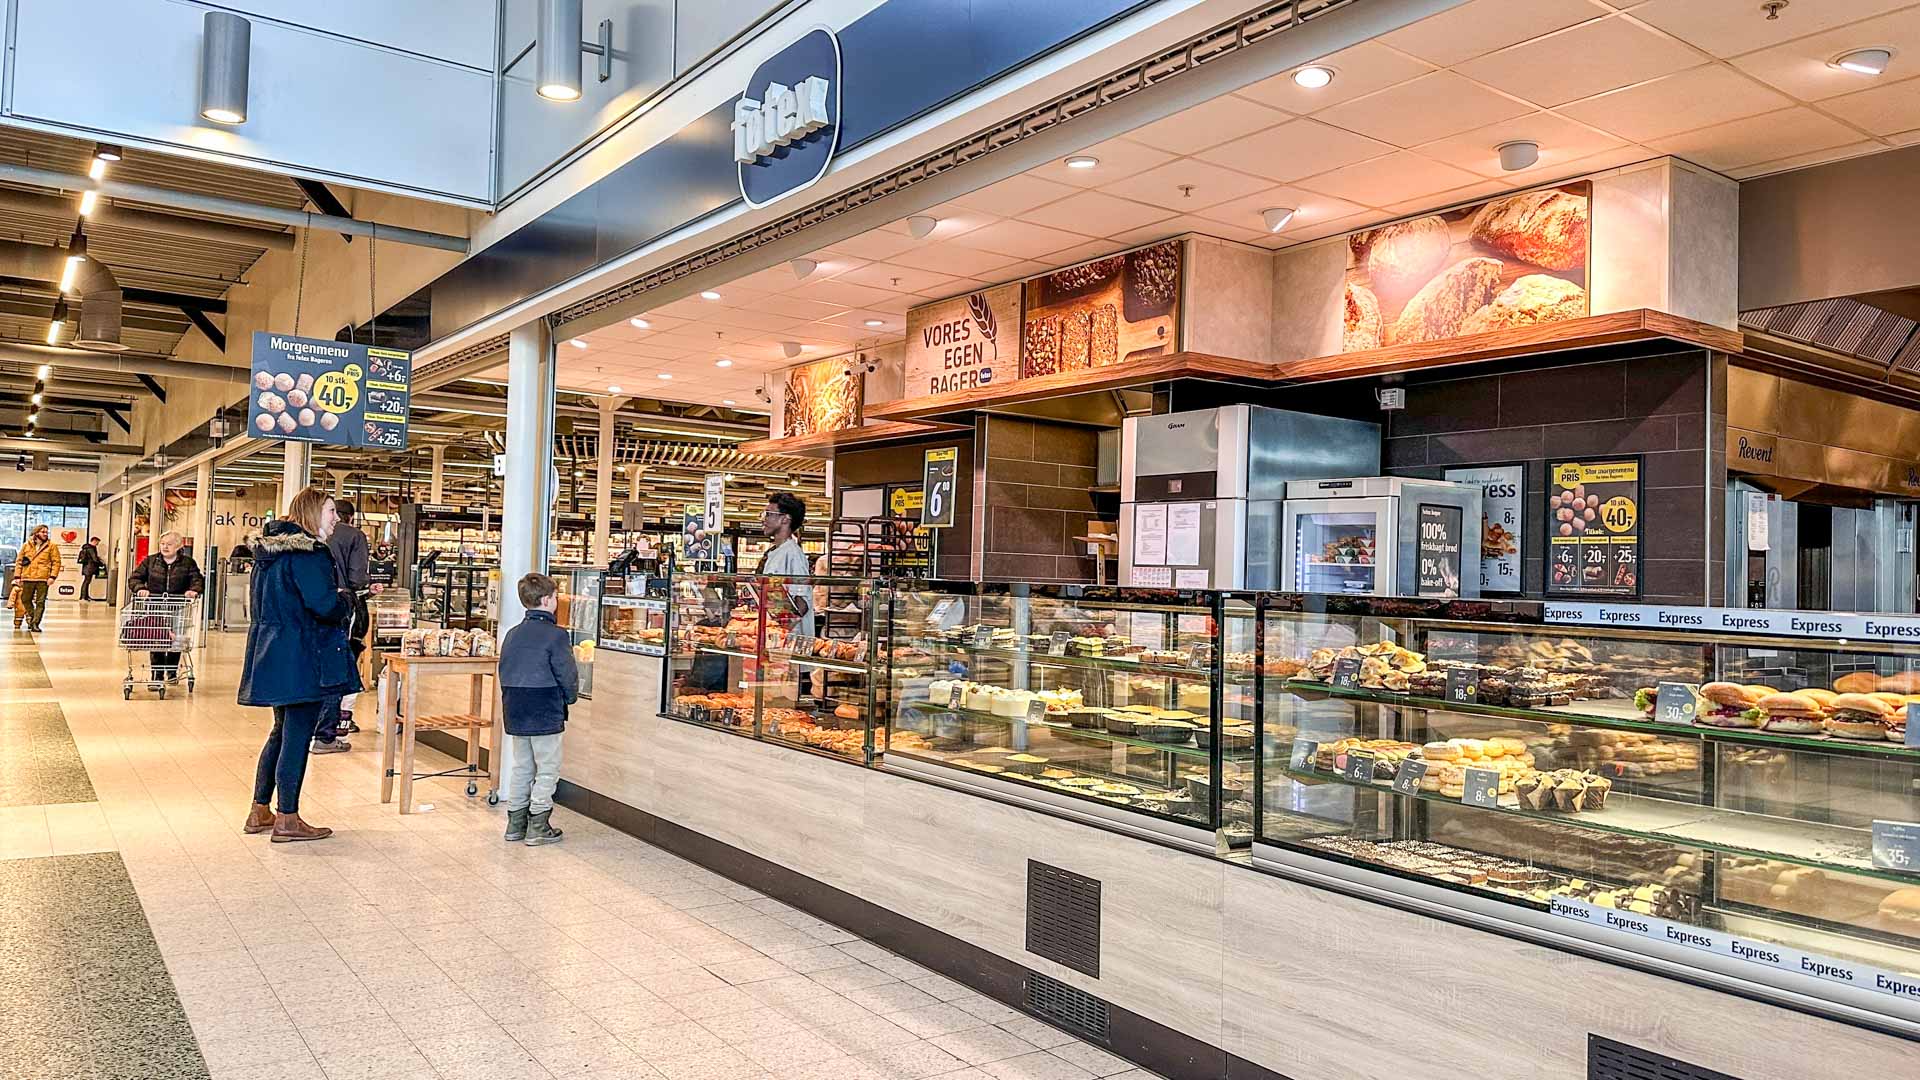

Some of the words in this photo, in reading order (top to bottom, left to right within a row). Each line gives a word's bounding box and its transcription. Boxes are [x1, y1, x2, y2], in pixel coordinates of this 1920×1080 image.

[923, 318, 970, 348] VORES
[270, 336, 349, 358] Morgenmenu
[944, 342, 983, 370] EGEN
[325, 375, 334, 383] 10
[335, 377, 349, 385] stk.
[930, 370, 978, 395] BAGER
[1738, 436, 1773, 463] Revent
[1561, 473, 1580, 482] PRIS
[930, 482, 942, 517] 6
[1482, 483, 1516, 498] ress
[1421, 522, 1447, 540] 100%
[1421, 541, 1445, 554] friskbagt
[1421, 558, 1437, 575] 0%
[1544, 607, 1583, 620] Express
[1600, 608, 1641, 622] Express
[1658, 611, 1703, 625] Express
[1722, 614, 1770, 630] Express
[1791, 617, 1842, 634] Express
[1865, 621, 1920, 638] Express
[1551, 899, 1590, 919] Express
[1607, 912, 1648, 933] Express
[1667, 926, 1712, 947] Express
[1731, 941, 1780, 963] Express
[1801, 957, 1853, 981] Express
